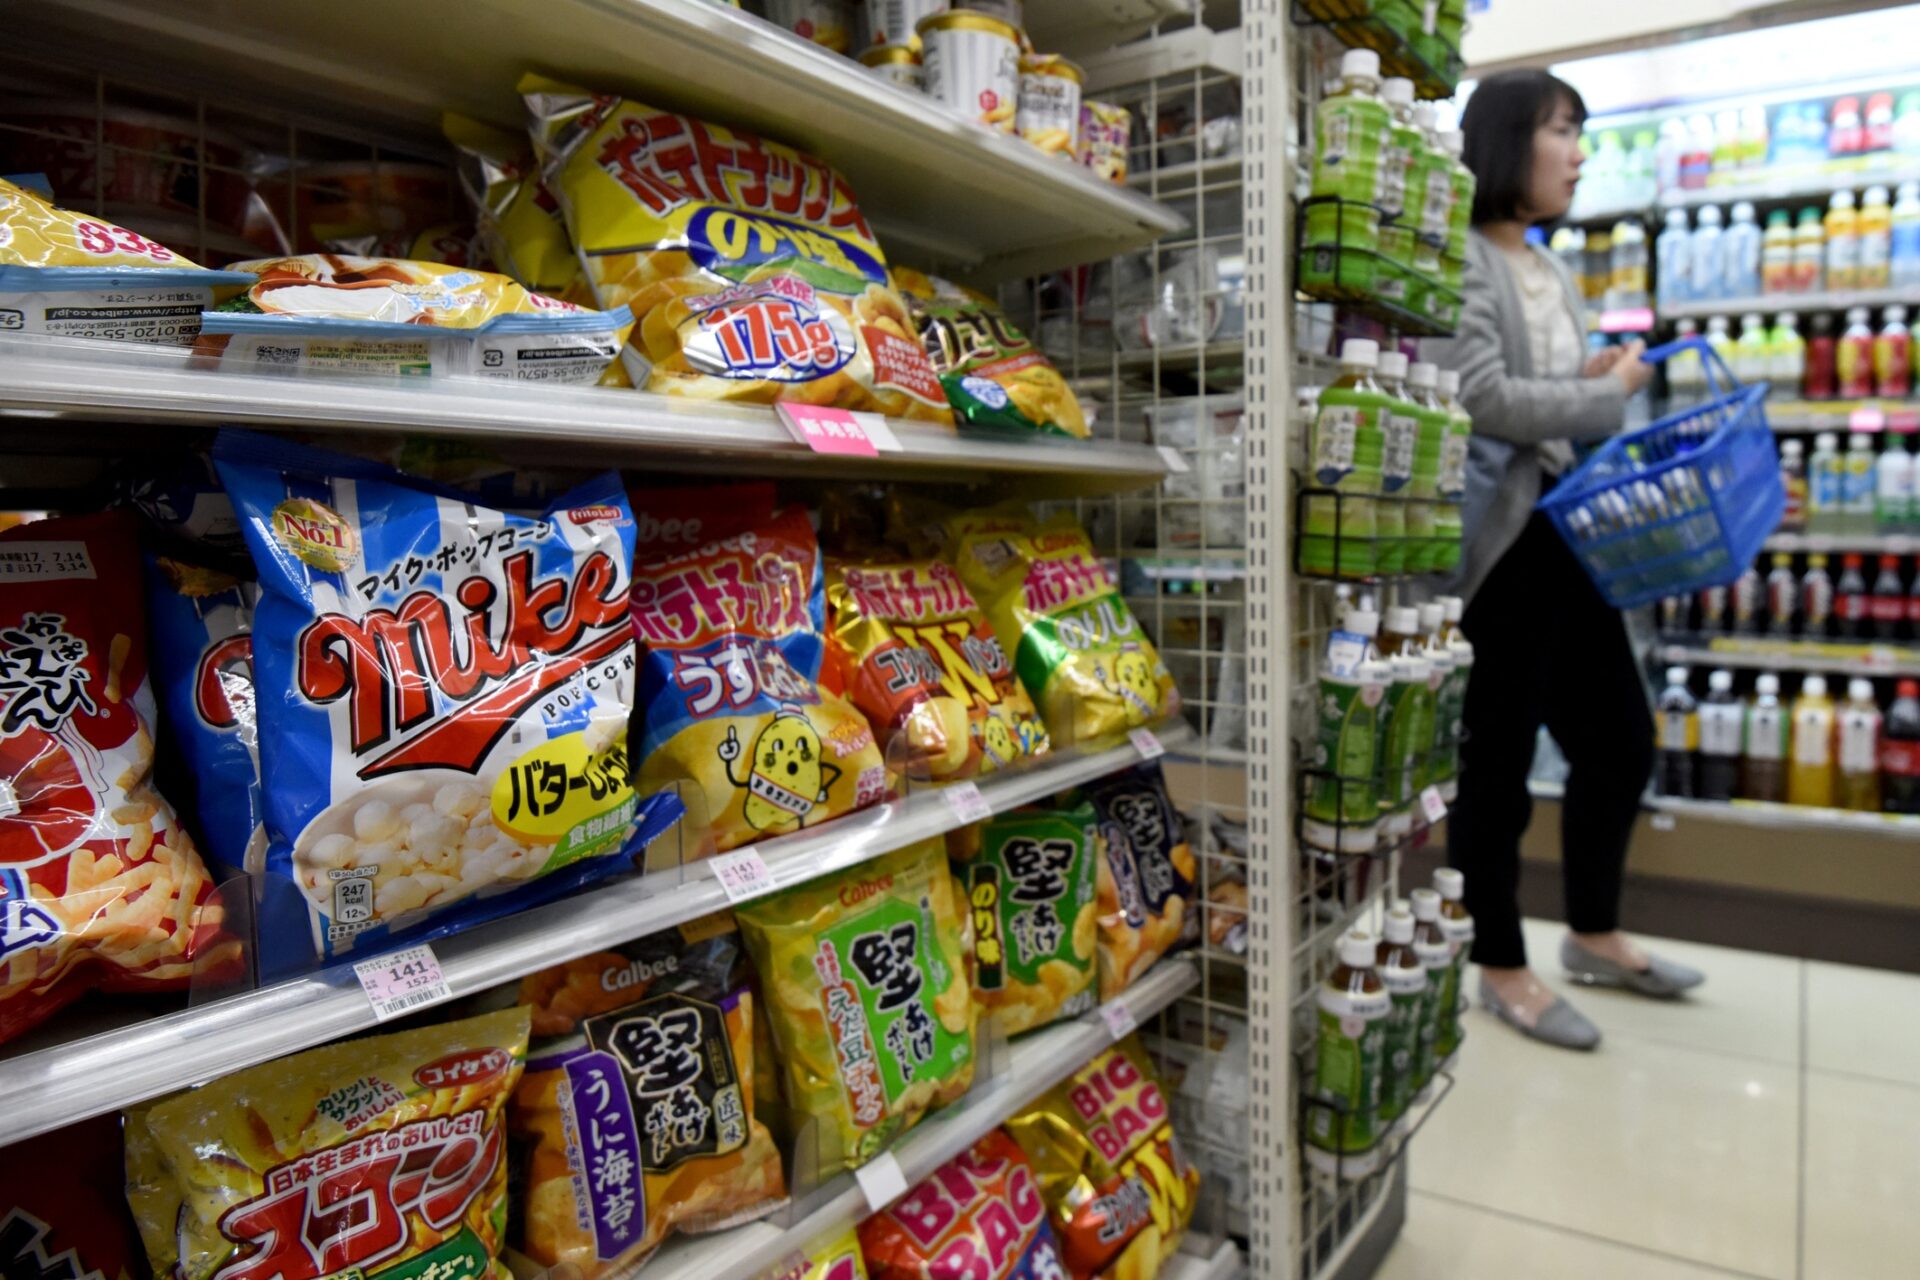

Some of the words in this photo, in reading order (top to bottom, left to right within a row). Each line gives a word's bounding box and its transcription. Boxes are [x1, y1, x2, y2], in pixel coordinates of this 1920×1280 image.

[597, 112, 874, 238] ポテトチップス
[703, 302, 838, 369] 175g
[356, 520, 553, 601] マイク・ポップコーン
[543, 654, 635, 719] POPCOR
[342, 884, 366, 897] 247
[345, 896, 364, 905] kcal
[839, 873, 895, 908] Calbee
[971, 883, 1001, 966] のり味
[389, 960, 428, 982] 141
[601, 953, 680, 993] Calbee
[425, 1053, 504, 1085] コイケヤ
[1069, 1054, 1139, 1122] BIG
[273, 1112, 484, 1194] 日本生まれのおいしさ!
[585, 1068, 636, 1242] うに海苔味
[1087, 1081, 1166, 1165] BAG
[927, 1167, 1042, 1280] BAG
